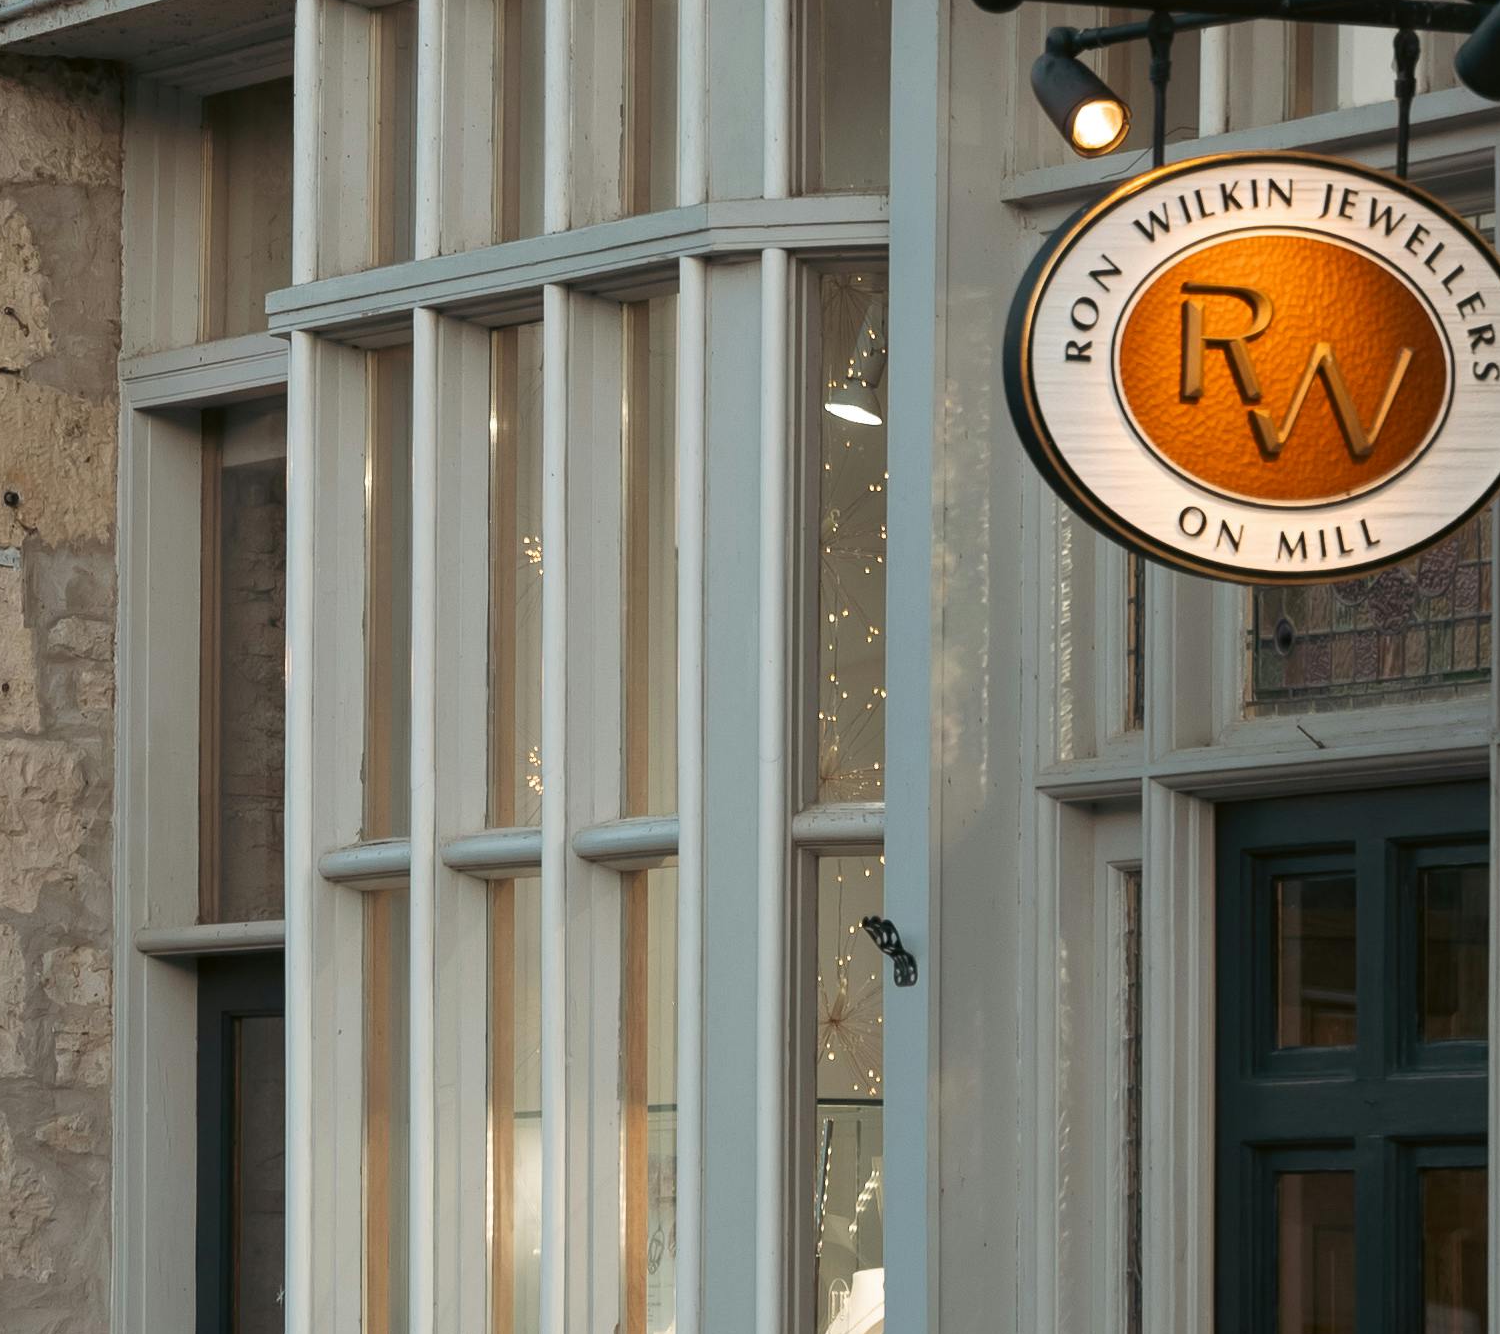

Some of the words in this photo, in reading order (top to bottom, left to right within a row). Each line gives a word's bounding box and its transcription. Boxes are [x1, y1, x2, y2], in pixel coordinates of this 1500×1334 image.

[1066, 254, 1123, 363] RON
[1133, 179, 1294, 244] WILKIN
[1180, 280, 1414, 461] RW
[1178, 506, 1245, 554] ON
[1276, 518, 1381, 562] MILL
